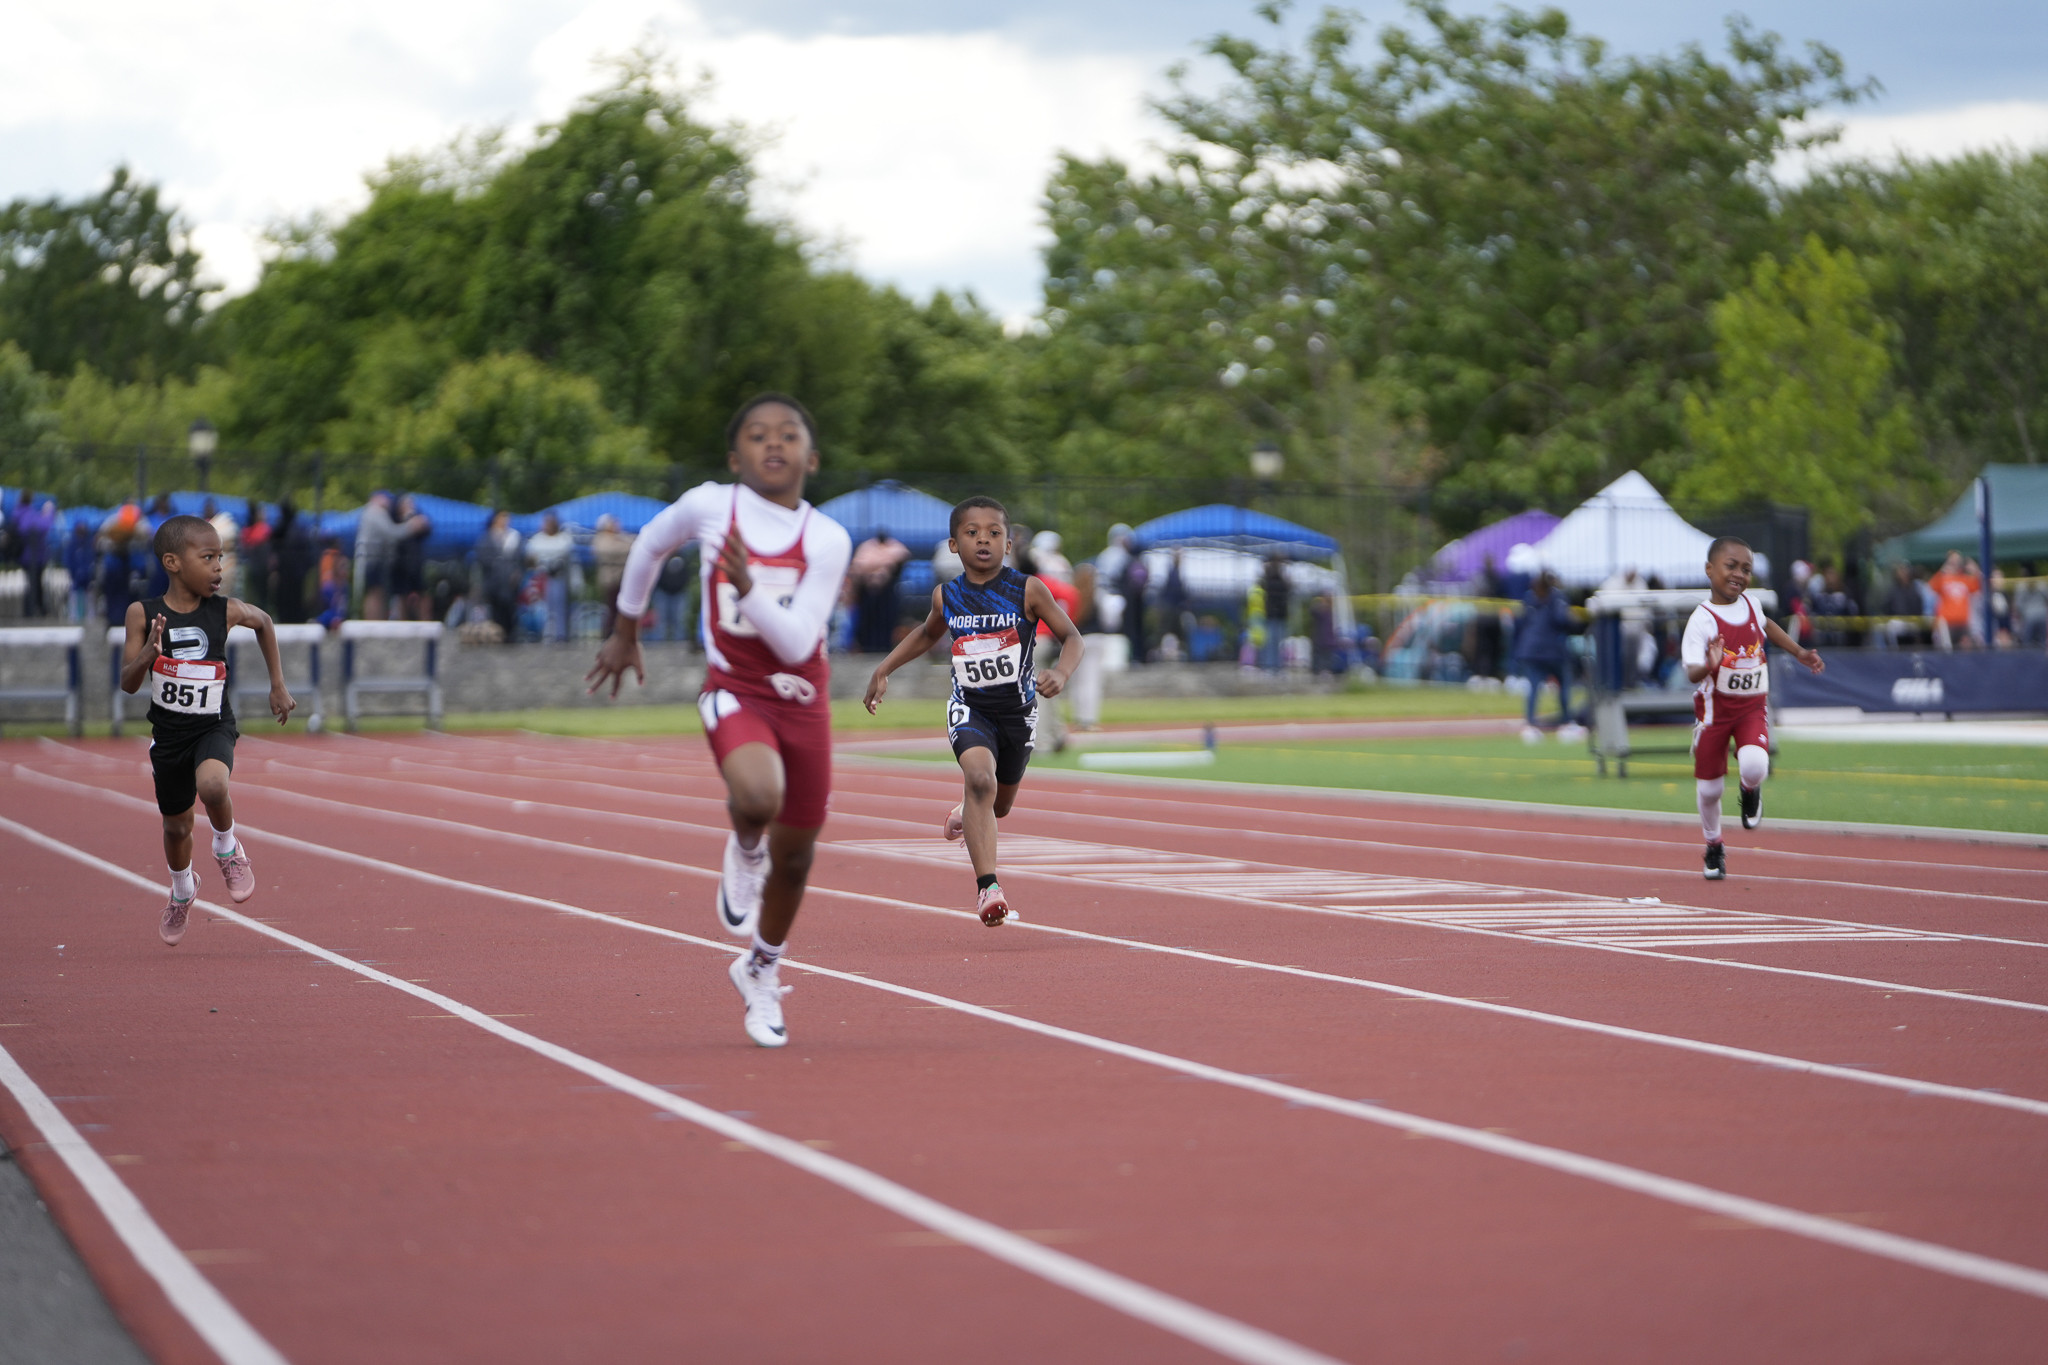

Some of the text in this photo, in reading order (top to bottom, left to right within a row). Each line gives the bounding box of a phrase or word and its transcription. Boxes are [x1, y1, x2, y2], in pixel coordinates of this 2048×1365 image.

[949, 613, 1017, 629] MOBETTAH
[964, 654, 1014, 683] 566
[1728, 671, 1762, 690] 687
[161, 681, 209, 707] 851
